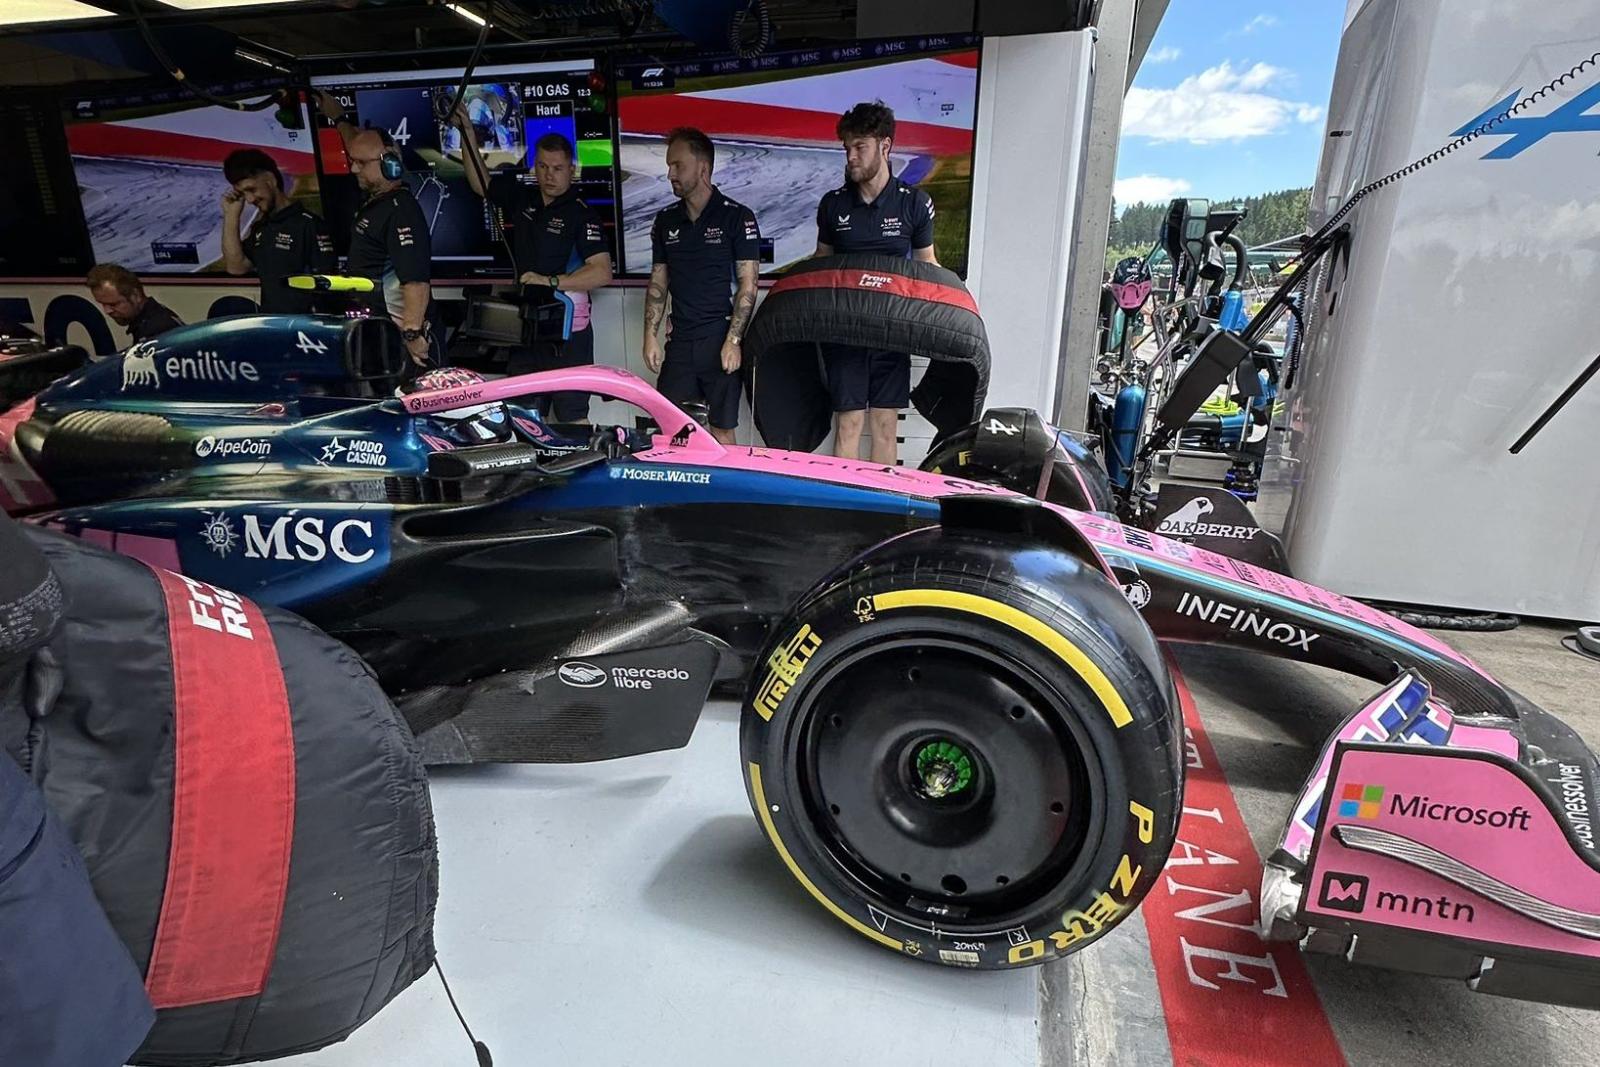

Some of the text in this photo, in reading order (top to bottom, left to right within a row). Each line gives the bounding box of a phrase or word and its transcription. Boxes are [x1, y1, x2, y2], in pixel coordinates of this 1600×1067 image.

[524, 84, 570, 98] #10 GAS
[536, 103, 560, 116] Hard
[859, 280, 883, 289] Left
[862, 273, 893, 284] Front
[165, 351, 260, 382] enilive
[421, 389, 483, 408] businessolver
[214, 440, 272, 455] ApeCoin
[349, 440, 384, 453] MODO
[346, 451, 388, 466] CASINO
[622, 468, 710, 484] MOSER.WATCH
[1156, 519, 1261, 540] OAKBERRY
[243, 515, 375, 563] MSC
[1176, 592, 1320, 652] INFINOX
[612, 667, 690, 681] mercado
[753, 624, 824, 723] PIRELLI
[614, 677, 652, 690] libre
[1390, 793, 1531, 831] Microsoft
[1008, 800, 1154, 964] P ZERO
[1376, 888, 1475, 923] mntn
